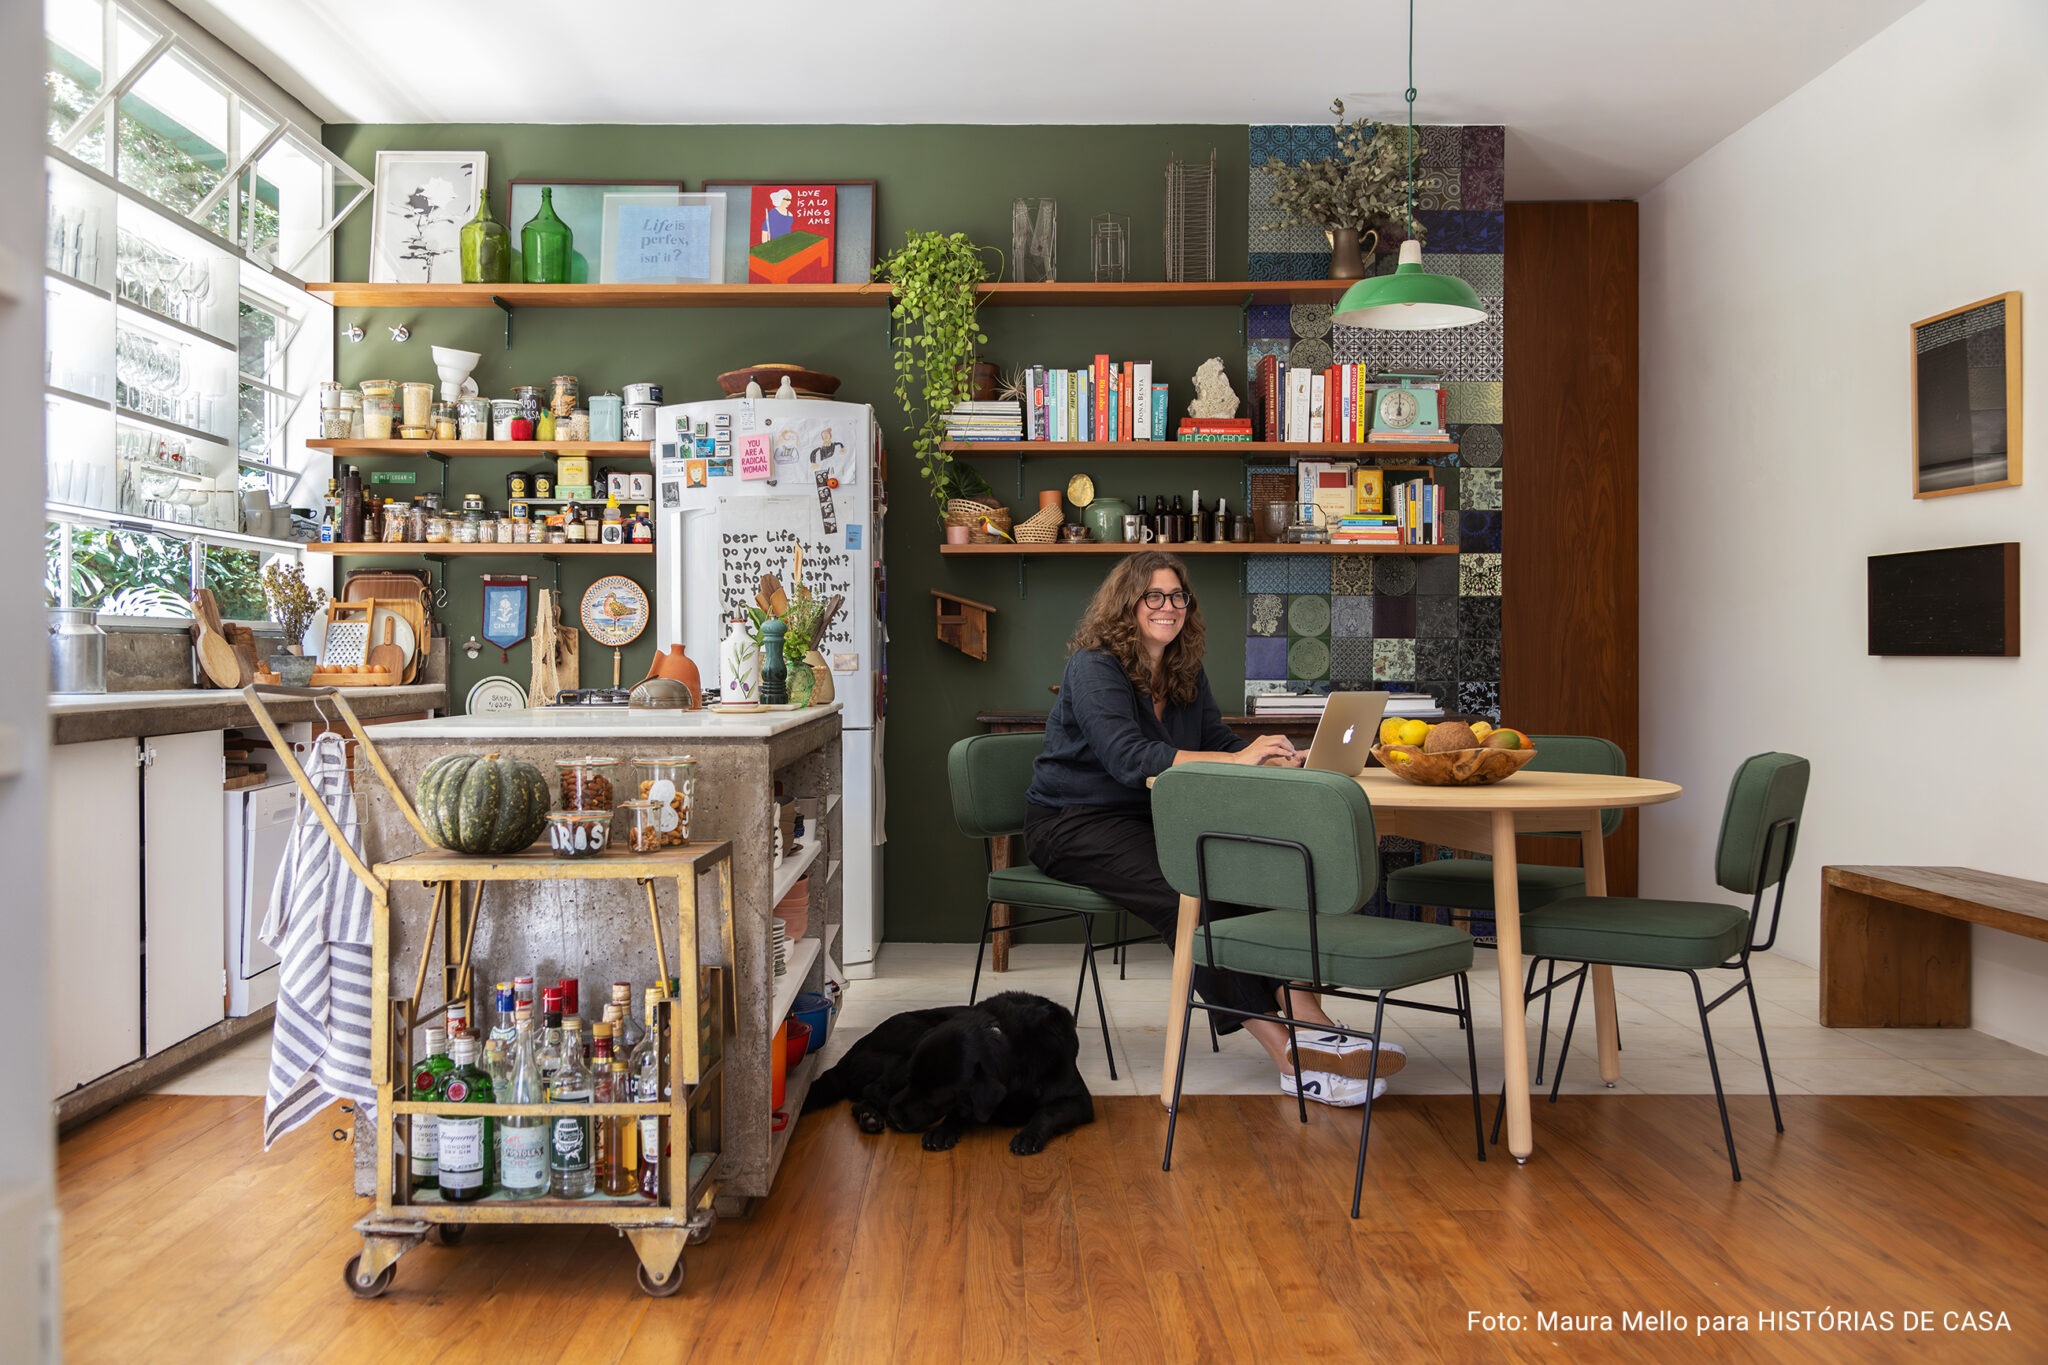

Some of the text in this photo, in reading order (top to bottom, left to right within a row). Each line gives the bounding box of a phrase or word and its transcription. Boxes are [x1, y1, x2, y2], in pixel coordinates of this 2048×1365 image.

[817, 198, 828, 206] LO
[643, 219, 686, 234] Life is
[808, 217, 830, 225] AME
[1099, 379, 1107, 393] Rita
[1098, 393, 1107, 411] Lobo
[747, 439, 761, 448] YOU
[745, 448, 757, 456] ARE
[741, 456, 768, 466] RADICAL
[742, 464, 768, 474] WOMAN
[722, 529, 800, 545] Dear Life,
[722, 541, 831, 561] Do you wat to
[724, 554, 850, 576] hang out onight?
[734, 568, 783, 584] shod
[722, 587, 745, 602] you
[831, 581, 851, 592] not
